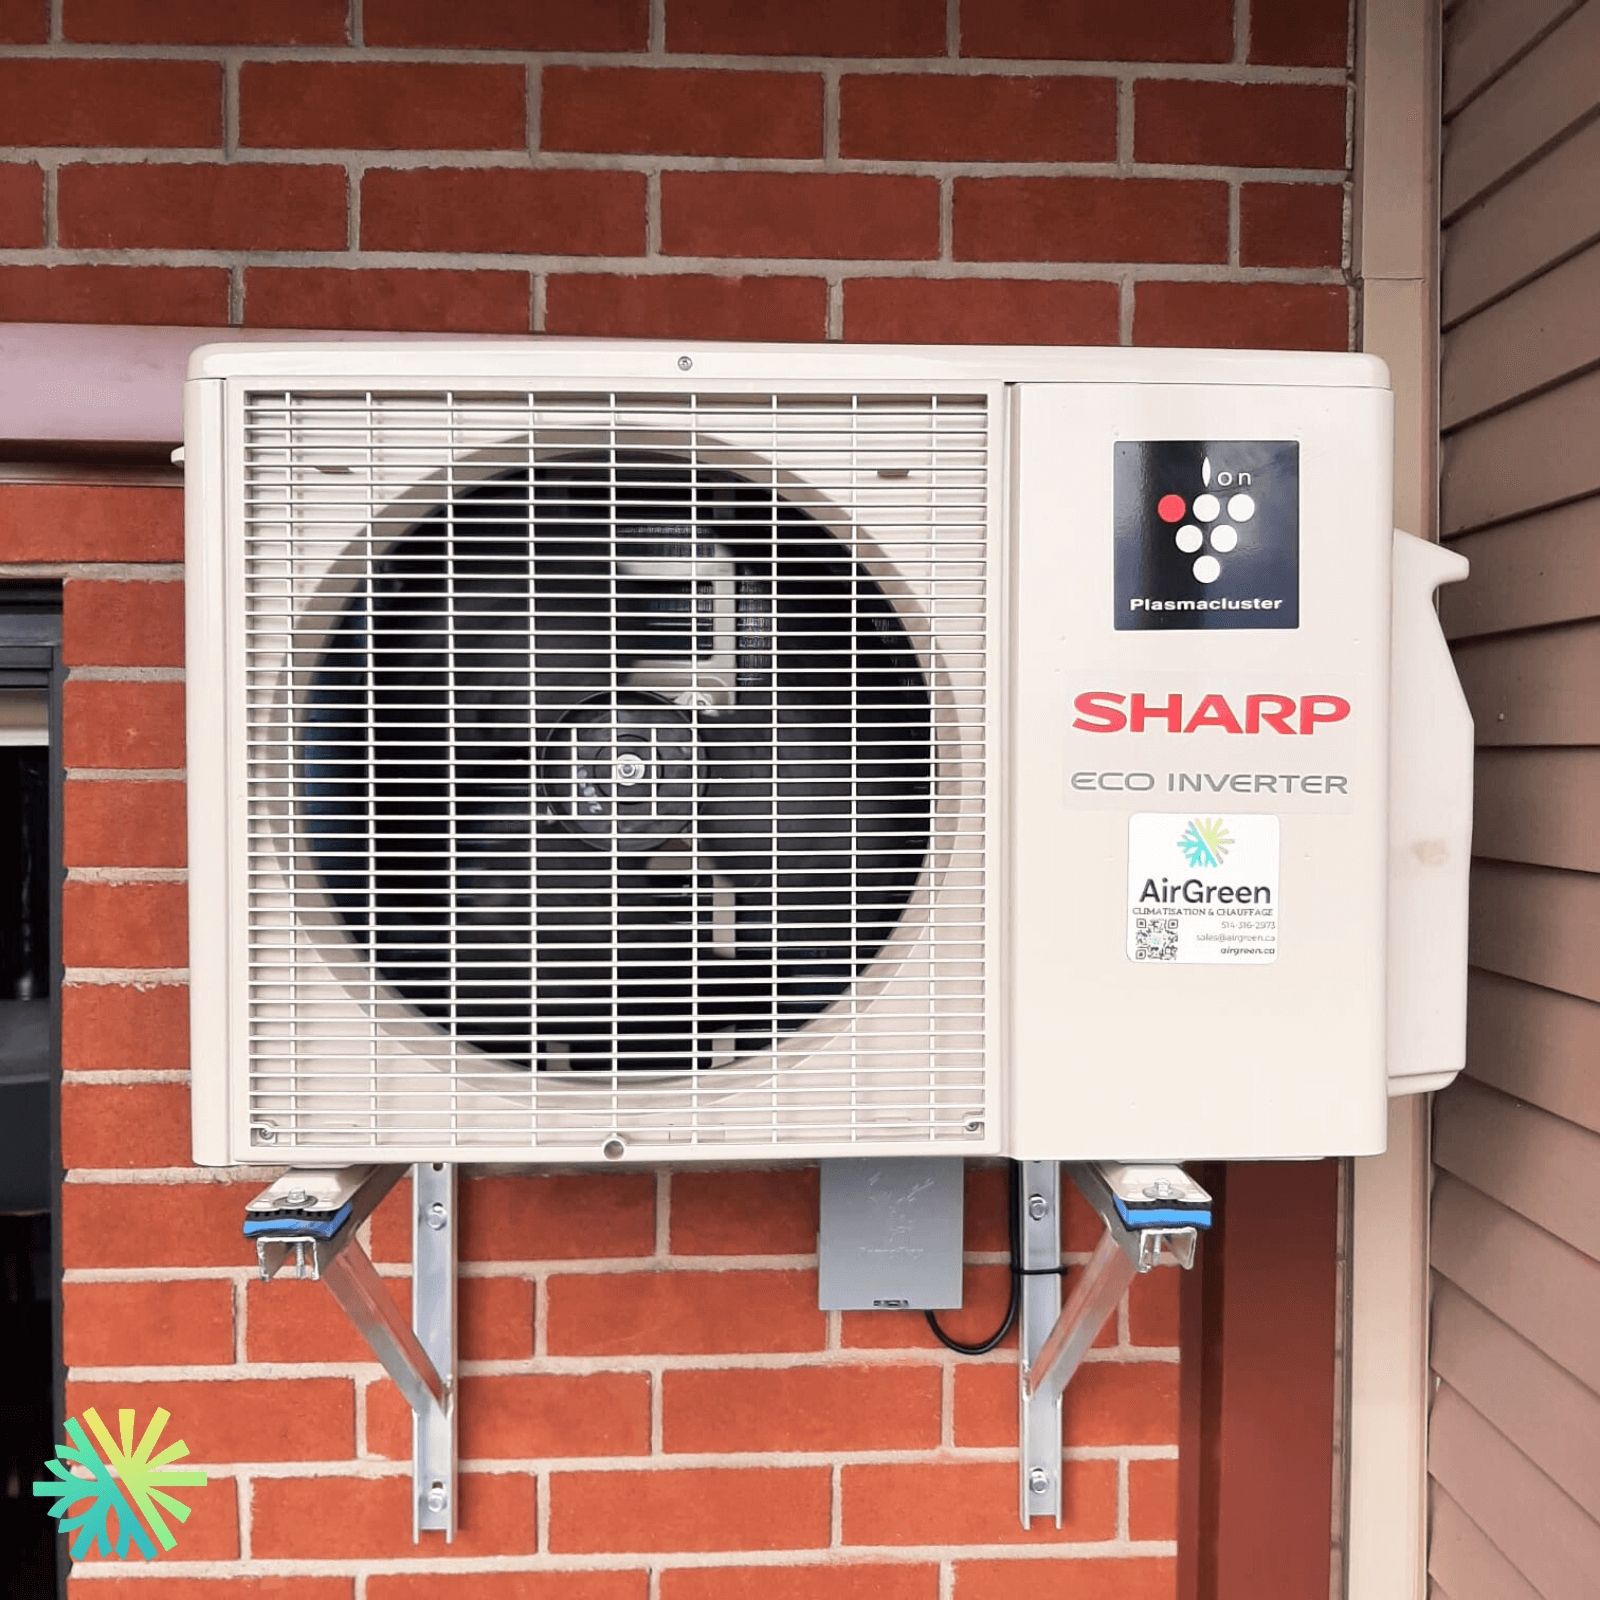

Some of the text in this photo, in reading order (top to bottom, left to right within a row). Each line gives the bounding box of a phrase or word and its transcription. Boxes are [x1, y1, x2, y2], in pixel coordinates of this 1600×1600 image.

[1130, 598, 1283, 611] Plasmacluster
[1072, 691, 1351, 735] SHARP
[1071, 772, 1348, 794] ECO INVERTER
[1139, 877, 1271, 904] AirGreen
[1132, 907, 1273, 916] CLIMATISATION & CHAUFFAGE
[1221, 921, 1276, 930] 514-316-2973
[1196, 933, 1276, 943] sales@airgreen.ca
[1220, 946, 1276, 956] airgreen.ca
